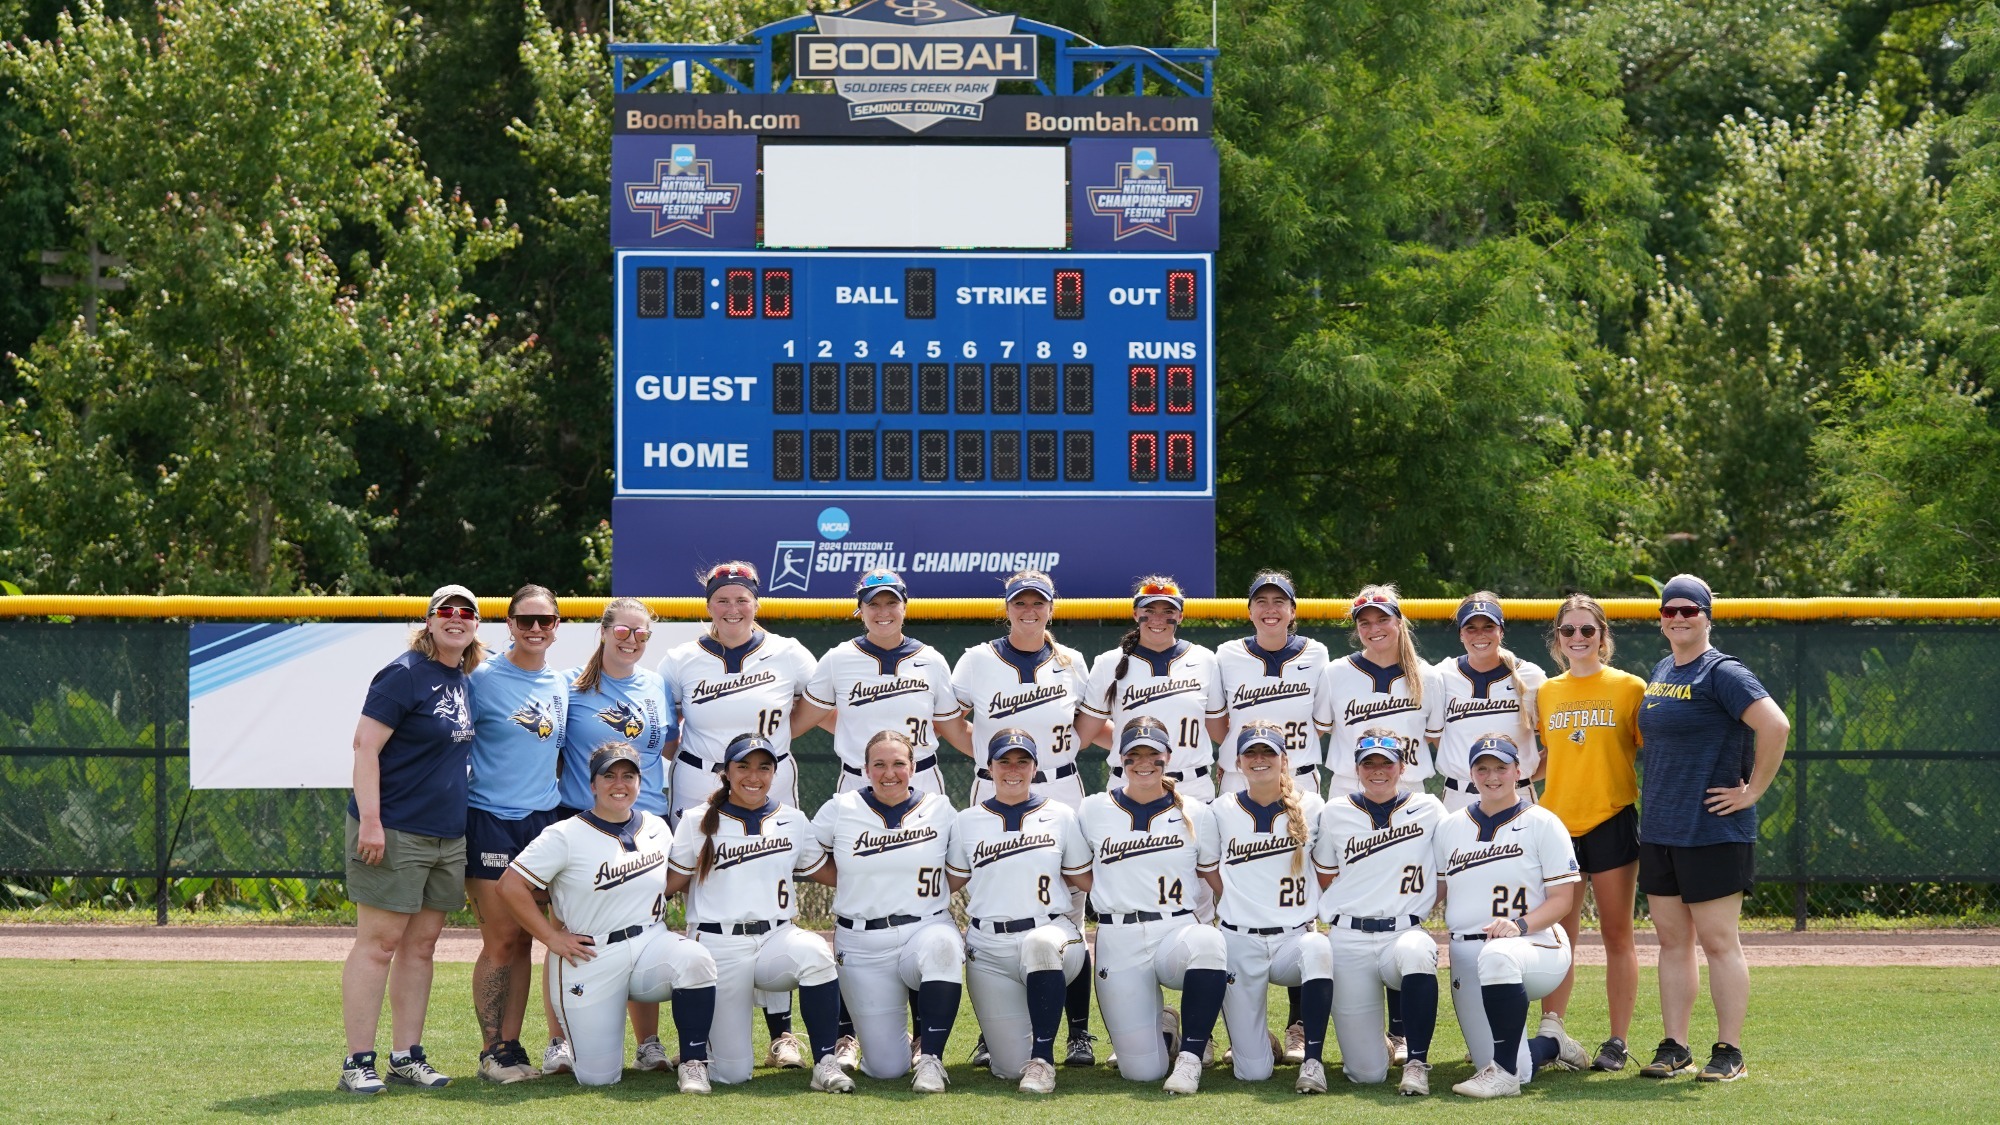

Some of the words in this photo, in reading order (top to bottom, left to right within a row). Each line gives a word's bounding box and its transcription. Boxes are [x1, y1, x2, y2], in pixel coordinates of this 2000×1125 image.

[809, 43, 1022, 70] BOOMBAH
[843, 82, 908, 94] SOLDIERS
[910, 82, 951, 93] CREEK
[955, 82, 991, 93] PARK
[626, 109, 800, 129] Boombah.com
[854, 102, 912, 116] SEMINOLE
[914, 102, 961, 115] COUNTY,
[963, 105, 977, 116] FL
[1025, 111, 1199, 132] Boombah.com
[635, 191, 732, 205] CHAMPIONSHIPS
[661, 181, 705, 191] NATIONAL
[1123, 185, 1167, 194] NATIONAL
[662, 205, 704, 215] FESTIVAL
[1098, 195, 1193, 207] CHAMPIONSHIPS
[1124, 208, 1166, 218] FESTIVAL
[836, 287, 899, 304] BALL
[956, 287, 1047, 305] STRIKE
[1109, 288, 1161, 305] OUT
[783, 340, 795, 358] 1
[818, 341, 832, 358] 2
[854, 341, 869, 358] 3
[890, 341, 905, 358] 4
[926, 341, 941, 358] 5
[962, 341, 977, 358] 6
[1000, 341, 1015, 358] 7
[1036, 341, 1051, 358] 8
[1072, 342, 1088, 359] 9
[1128, 342, 1197, 359] RUNS
[635, 375, 757, 401] GUEST
[644, 442, 748, 468] HOME
[821, 523, 849, 532] NCAA
[819, 542, 841, 551] 2024
[842, 542, 883, 551] DIVISION
[884, 542, 893, 551] II
[815, 552, 907, 573] SOFTBALL
[912, 552, 1060, 573] CHAMPIONSHIP
[692, 671, 776, 701] Augustana
[849, 678, 929, 703] Augustana
[1122, 678, 1201, 705] Augustana
[1233, 681, 1310, 706] Augustana
[988, 684, 1067, 715] Augustana
[1446, 698, 1519, 719] Augustana
[644, 698, 657, 749] BROTHERHOOD
[759, 709, 782, 737] 16
[1548, 708, 1617, 731] SOFTBALL
[1135, 727, 1150, 738] AU
[1178, 717, 1199, 748] 10
[1284, 721, 1307, 750] 25
[1481, 740, 1497, 749] AU
[714, 837, 792, 864] Augustana
[853, 826, 937, 853] Augustana
[973, 833, 1055, 862] Augustana
[1100, 834, 1184, 861] Augustana
[1344, 822, 1424, 858] Augustana
[594, 850, 664, 886] Augustana
[1446, 842, 1523, 871] Augustana
[917, 867, 942, 897] 50
[1038, 875, 1051, 905] 8
[1157, 875, 1183, 905] 14
[1279, 876, 1306, 907] 28
[1400, 865, 1425, 894] 20
[778, 879, 789, 909] 6
[1492, 885, 1529, 917] 24
